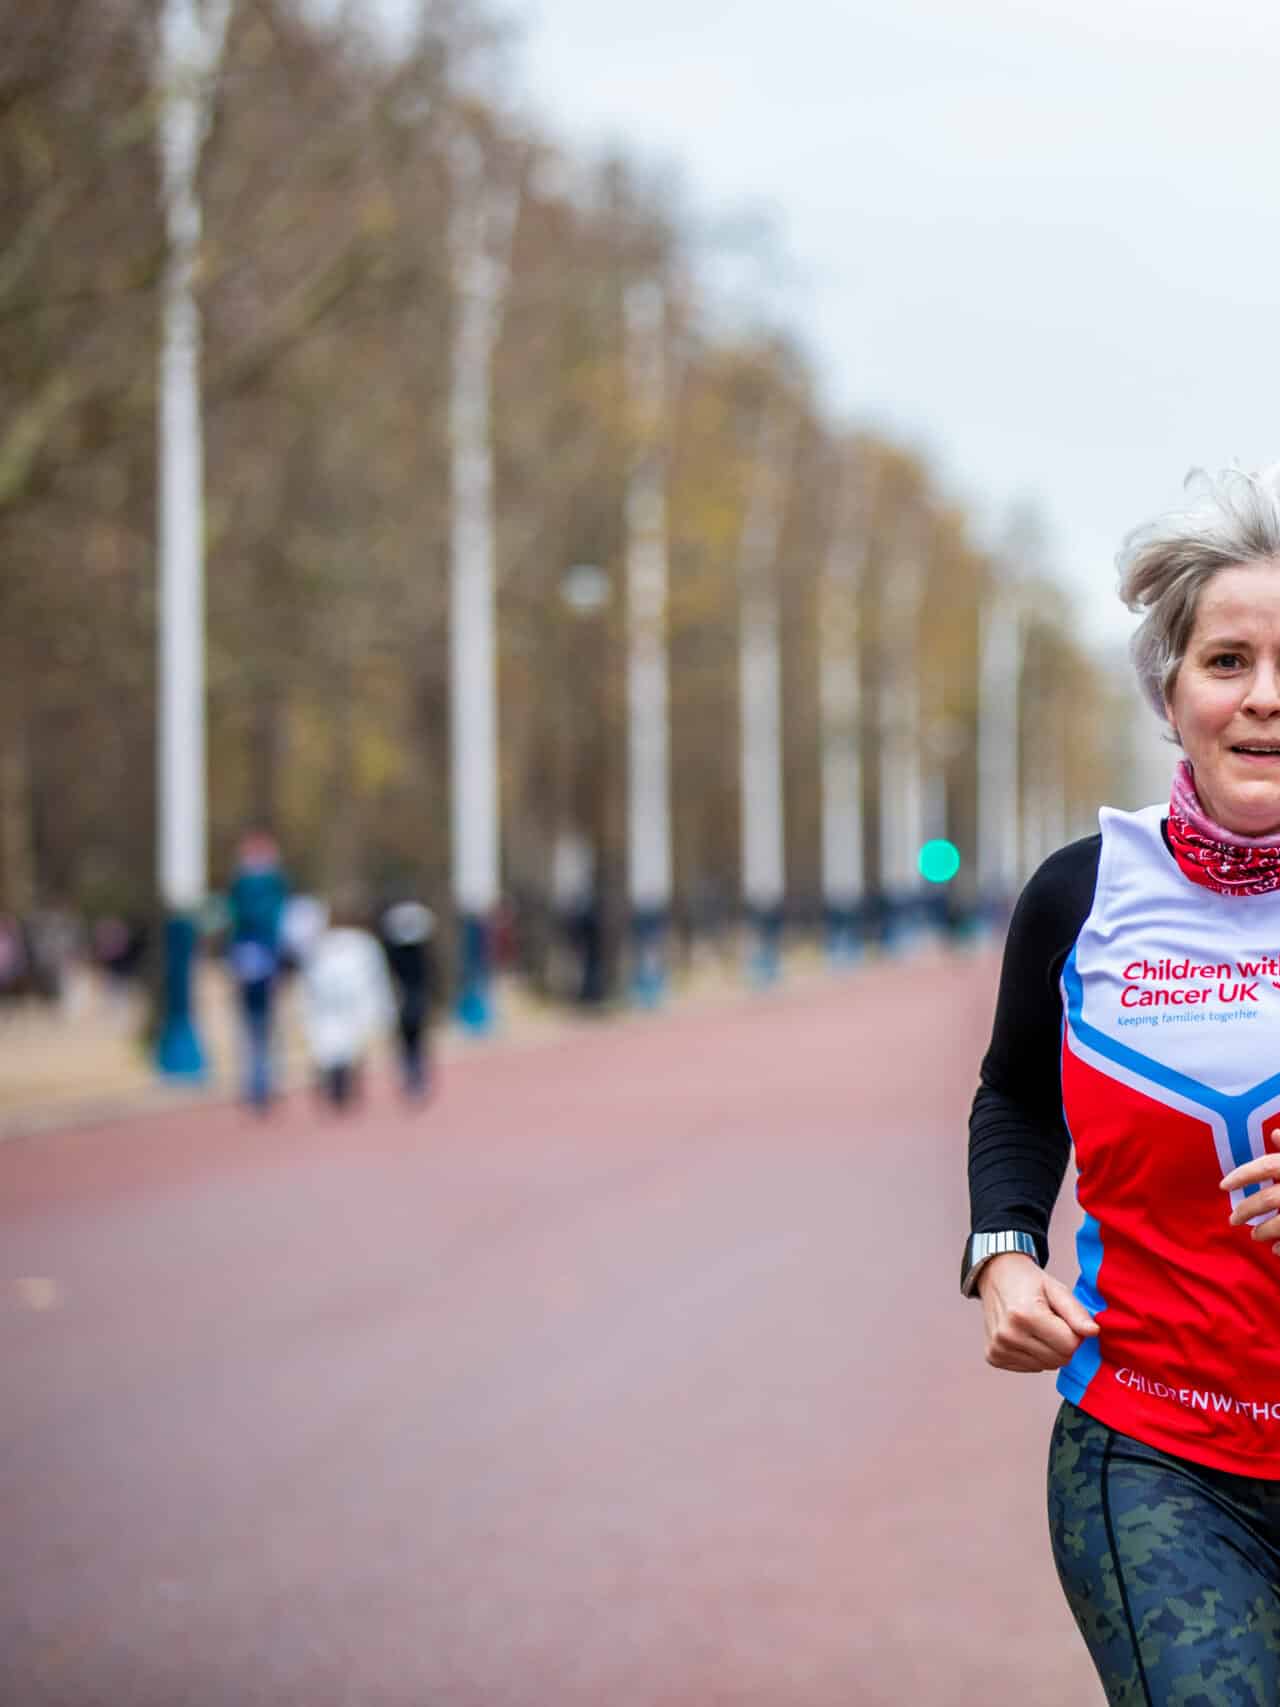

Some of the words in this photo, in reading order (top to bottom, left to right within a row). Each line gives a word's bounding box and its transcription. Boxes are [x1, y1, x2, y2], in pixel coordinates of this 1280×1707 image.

[1121, 958, 1232, 981] Children
[1120, 985, 1212, 1008] Cancer
[1218, 982, 1260, 1003] UK
[1117, 1014, 1159, 1027] Keeping
[1161, 1011, 1205, 1025] families
[1208, 1008, 1258, 1023] together
